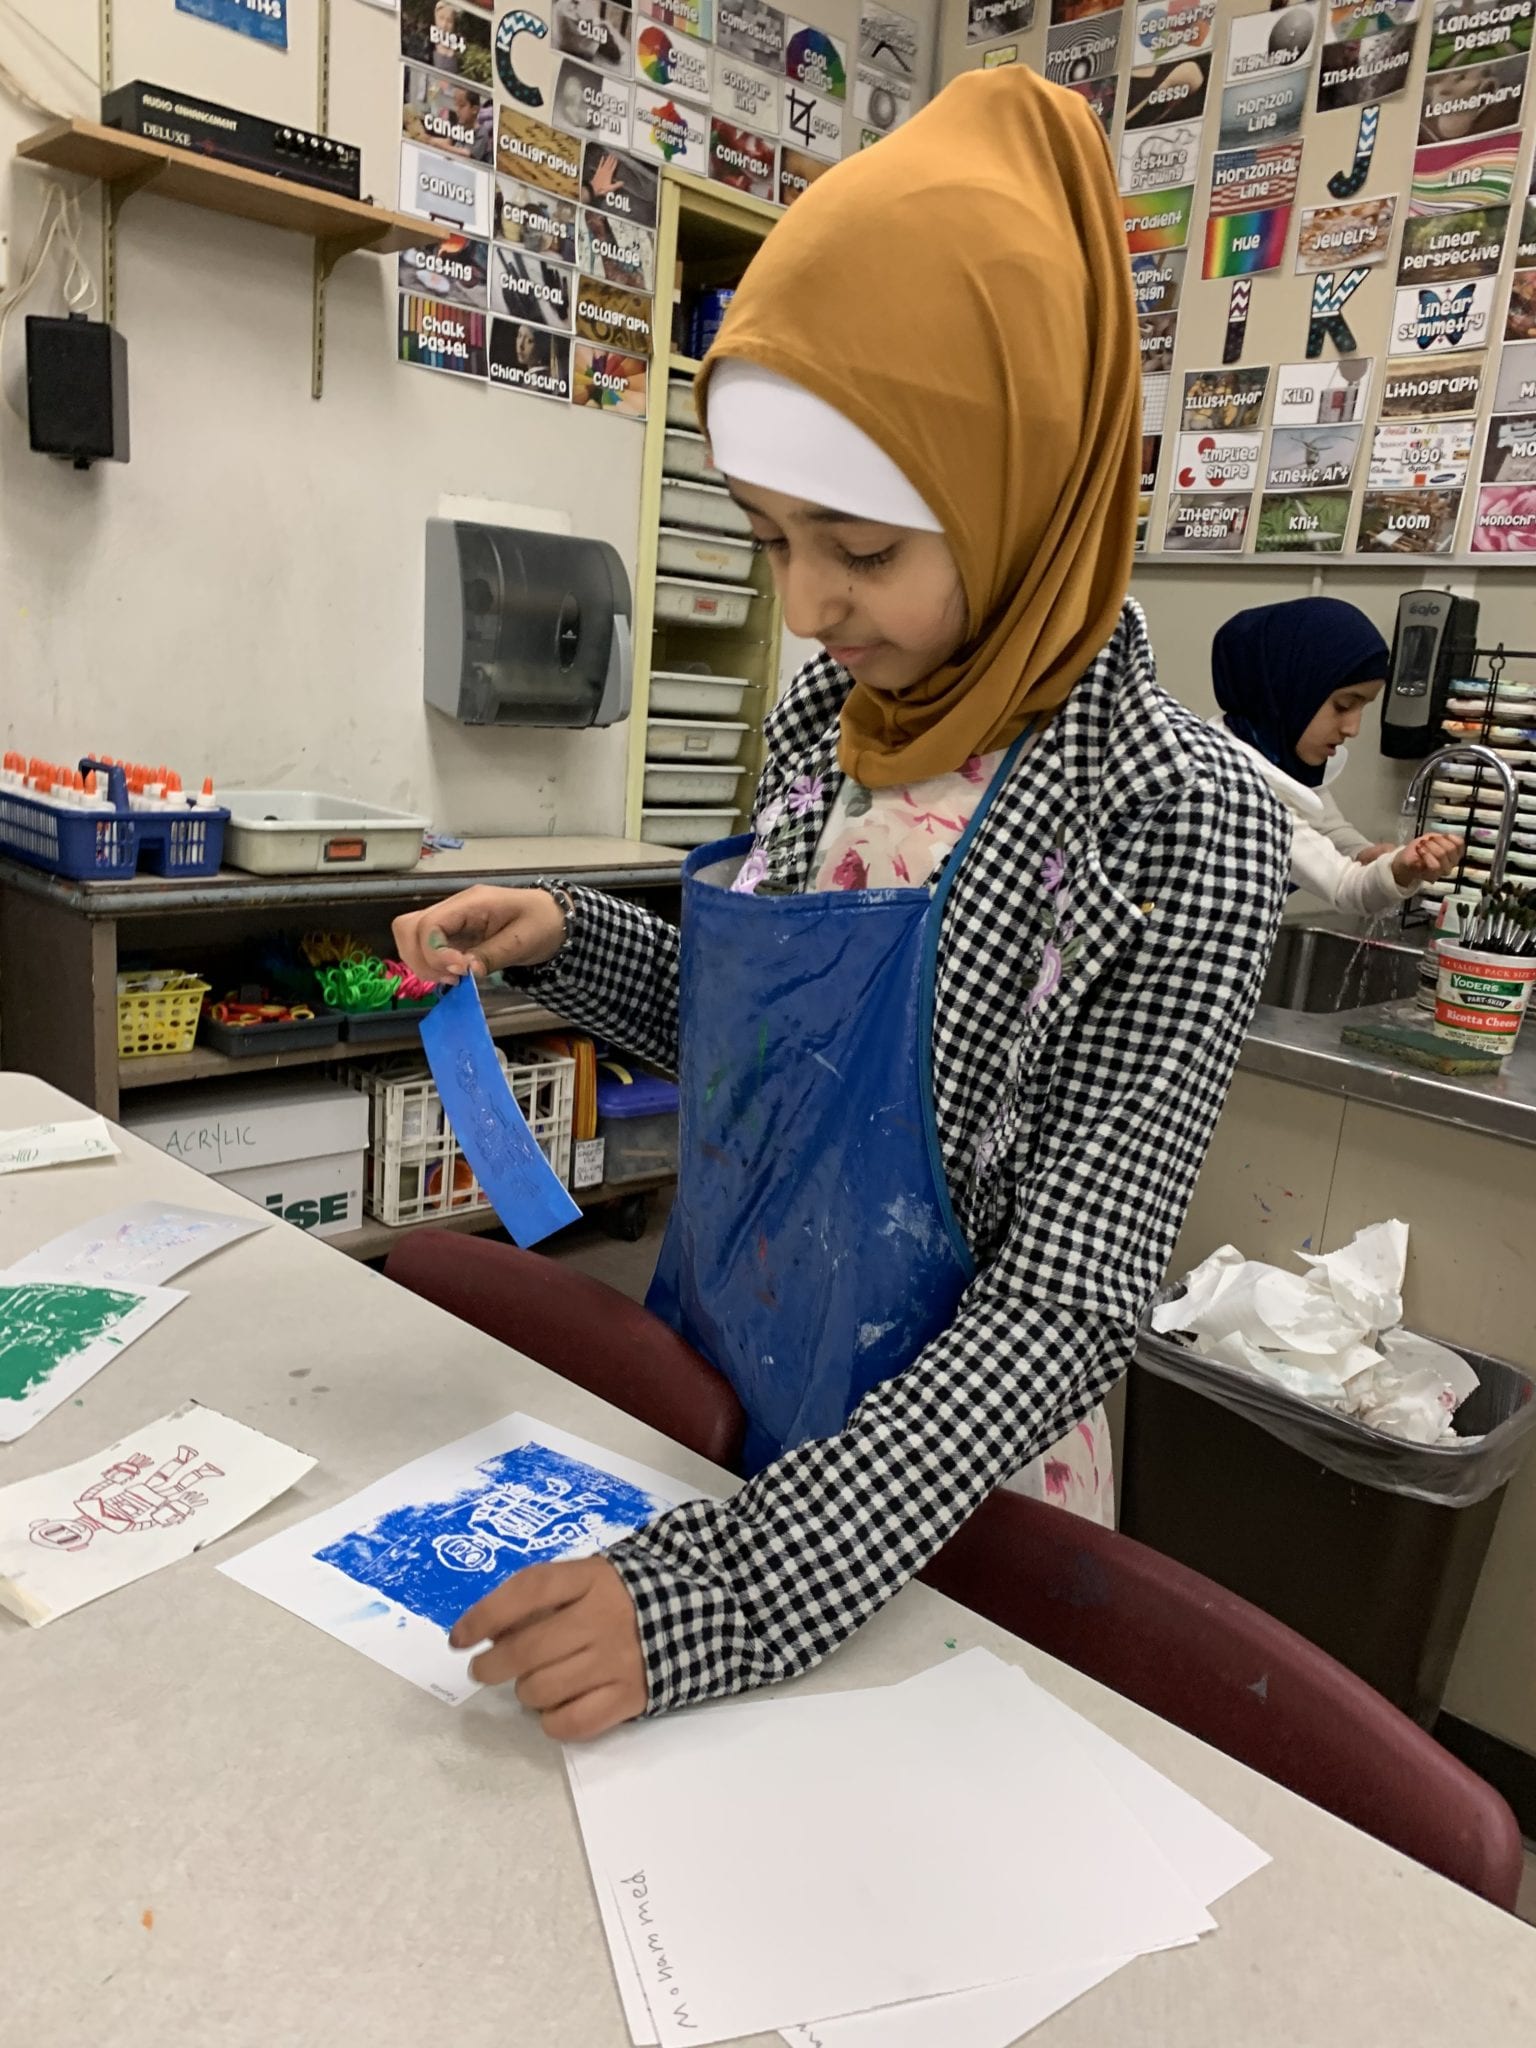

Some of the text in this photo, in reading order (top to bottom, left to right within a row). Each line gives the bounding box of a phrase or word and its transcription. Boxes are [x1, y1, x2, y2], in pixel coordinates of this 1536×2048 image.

[720, 10, 783, 48] Composition
[1140, 3, 1215, 35] Geometric
[1438, 2, 1531, 35] Landscape
[430, 26, 466, 54] Bust
[578, 20, 608, 44] Clay
[1150, 26, 1200, 50] Shapes
[1454, 26, 1511, 52] Design
[668, 48, 705, 74] Color
[804, 49, 828, 71] Cool
[1232, 47, 1300, 75] Highlight
[1322, 51, 1410, 87] Installation
[583, 87, 627, 118] Closed
[1149, 84, 1190, 105] Gesso
[1236, 90, 1293, 116] Horizon
[1425, 84, 1521, 118] Leatherhard
[142, 94, 238, 131] AUDIO ENHANCEMENT
[586, 109, 621, 135] Form
[1248, 112, 1278, 132] Line
[143, 122, 192, 146] DELUXE
[424, 113, 475, 144] Candid
[500, 135, 579, 178] Calligraphy
[716, 144, 769, 176] Contrast
[1131, 149, 1188, 172] Gesture
[1131, 166, 1183, 189] Drawing
[1216, 157, 1298, 186] Horizontal
[1448, 167, 1482, 187] Line
[419, 173, 474, 205] Canvas
[1239, 182, 1270, 200] Line
[606, 192, 632, 213] Coil
[503, 204, 567, 239] Ceramics
[1124, 209, 1182, 233] Gradient
[1232, 234, 1261, 252] Hue
[1312, 225, 1378, 250] Jewelry
[1430, 230, 1480, 250] Linear
[591, 238, 641, 267] Collage
[1403, 244, 1500, 270] Perspective
[415, 252, 472, 281] Casting
[1131, 268, 1173, 285] raphic
[500, 273, 564, 305] Charcoal
[578, 301, 650, 334] Collagraph
[1305, 267, 1372, 359] K
[1416, 295, 1474, 319] Linear
[422, 315, 465, 338] Chalk
[1399, 312, 1485, 341] Symmetry
[418, 335, 469, 359] Pastel
[490, 362, 567, 393] Chiaroscuro
[593, 372, 629, 392] Color
[1385, 376, 1480, 398] Lithograph
[1185, 390, 1262, 410] Illustrator
[1282, 387, 1314, 405] Kiln
[1201, 447, 1258, 465] Implied
[1401, 448, 1442, 465] Logo
[1270, 465, 1349, 484] Kinetic Art
[1178, 506, 1241, 523] Interior
[1289, 516, 1320, 531] Knit
[1388, 514, 1430, 530] Loom
[1184, 523, 1229, 539] Design
[1446, 1009, 1483, 1025] Ricotta
[166, 1122, 257, 1164] ACRYLIC
